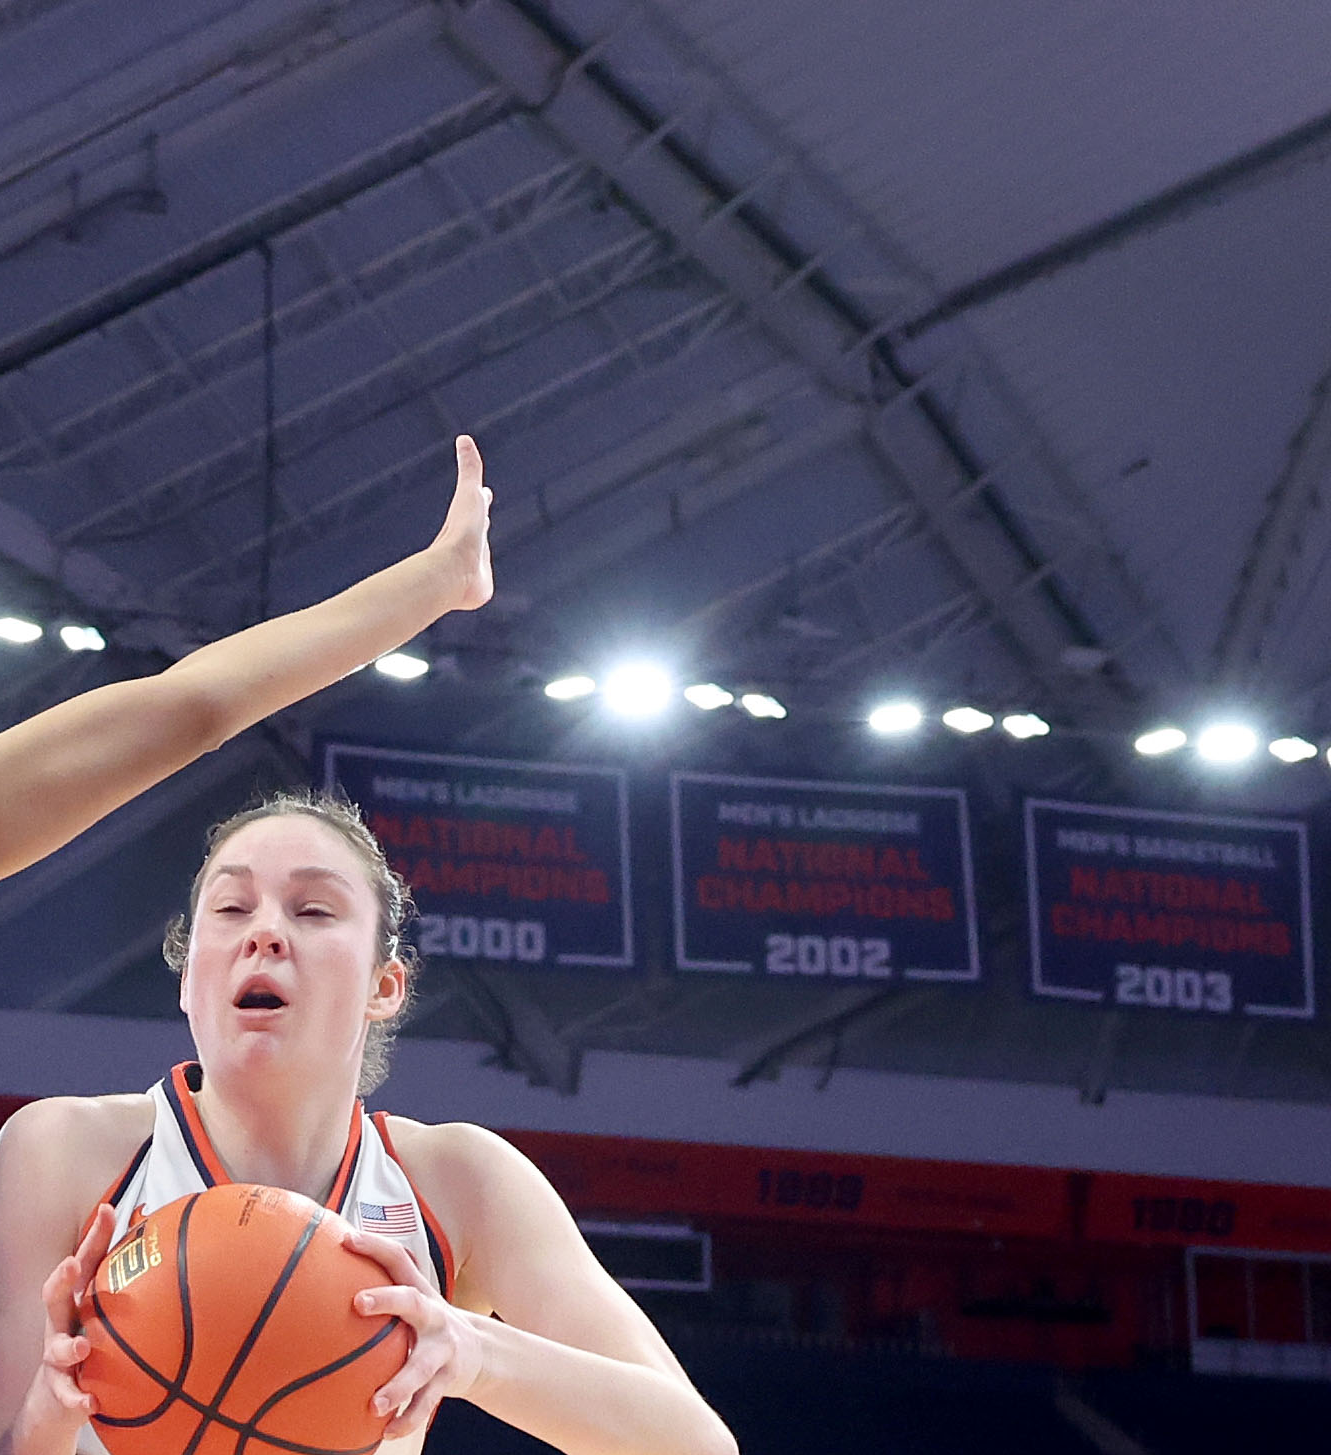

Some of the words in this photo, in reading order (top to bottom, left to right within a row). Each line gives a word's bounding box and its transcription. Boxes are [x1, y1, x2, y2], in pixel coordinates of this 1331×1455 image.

[371, 813, 589, 864] NATIONAL
[717, 836, 931, 881] NATIONAL
[394, 856, 611, 904] AMPIONS
[696, 874, 956, 922] CHAMPIONS
[1068, 864, 1274, 917] NATIONAL
[418, 914, 547, 962] 2000
[1050, 902, 1293, 956] CHAMPIONS
[765, 933, 893, 978] 2002
[1114, 964, 1234, 1014] 2003
